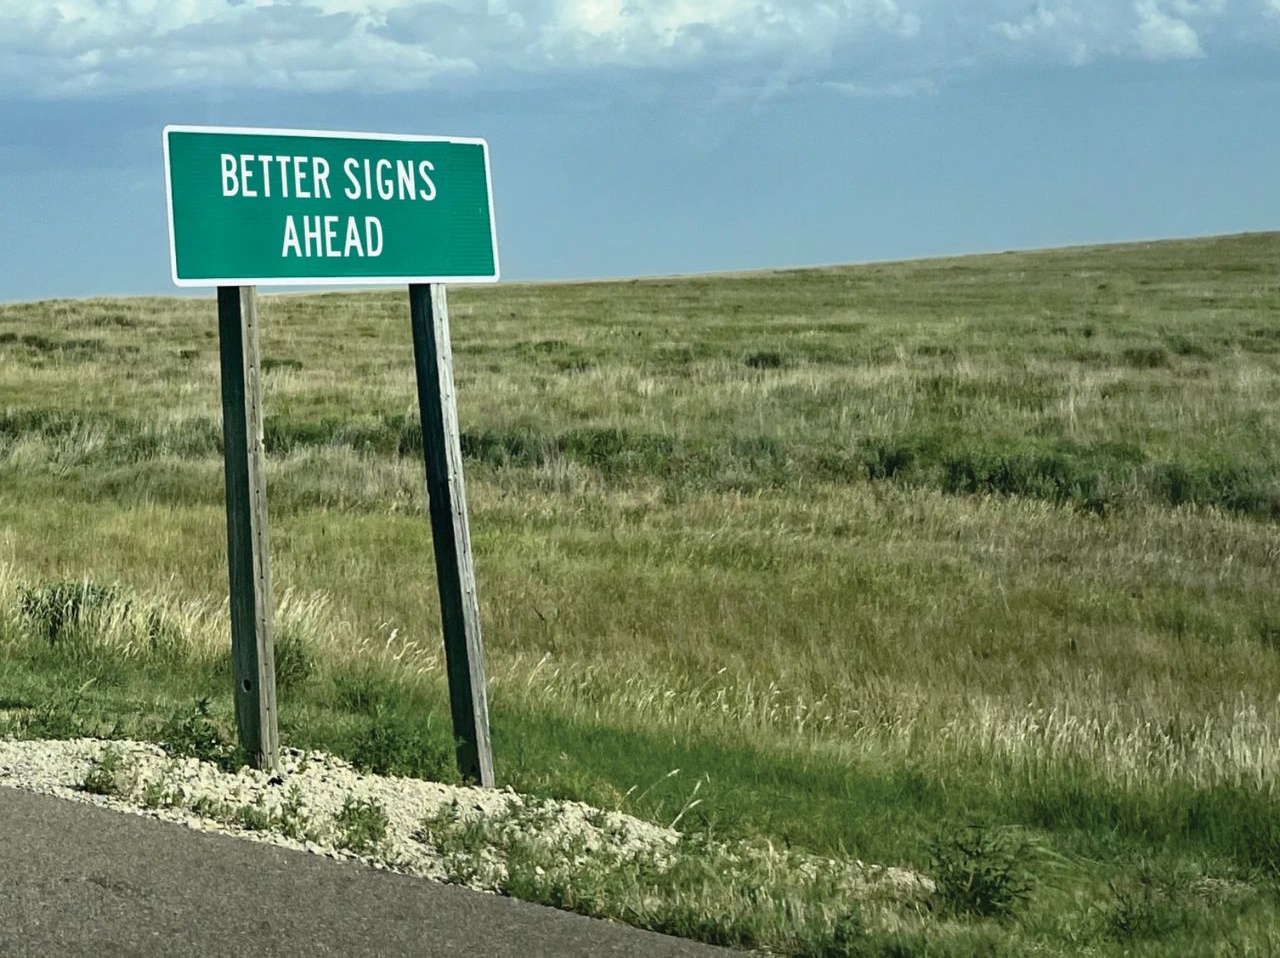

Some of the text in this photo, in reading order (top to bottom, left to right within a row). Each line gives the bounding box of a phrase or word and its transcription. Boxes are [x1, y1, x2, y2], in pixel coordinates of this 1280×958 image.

[221, 153, 437, 201] BETTER SIGNS
[282, 215, 383, 257] AHEAD
